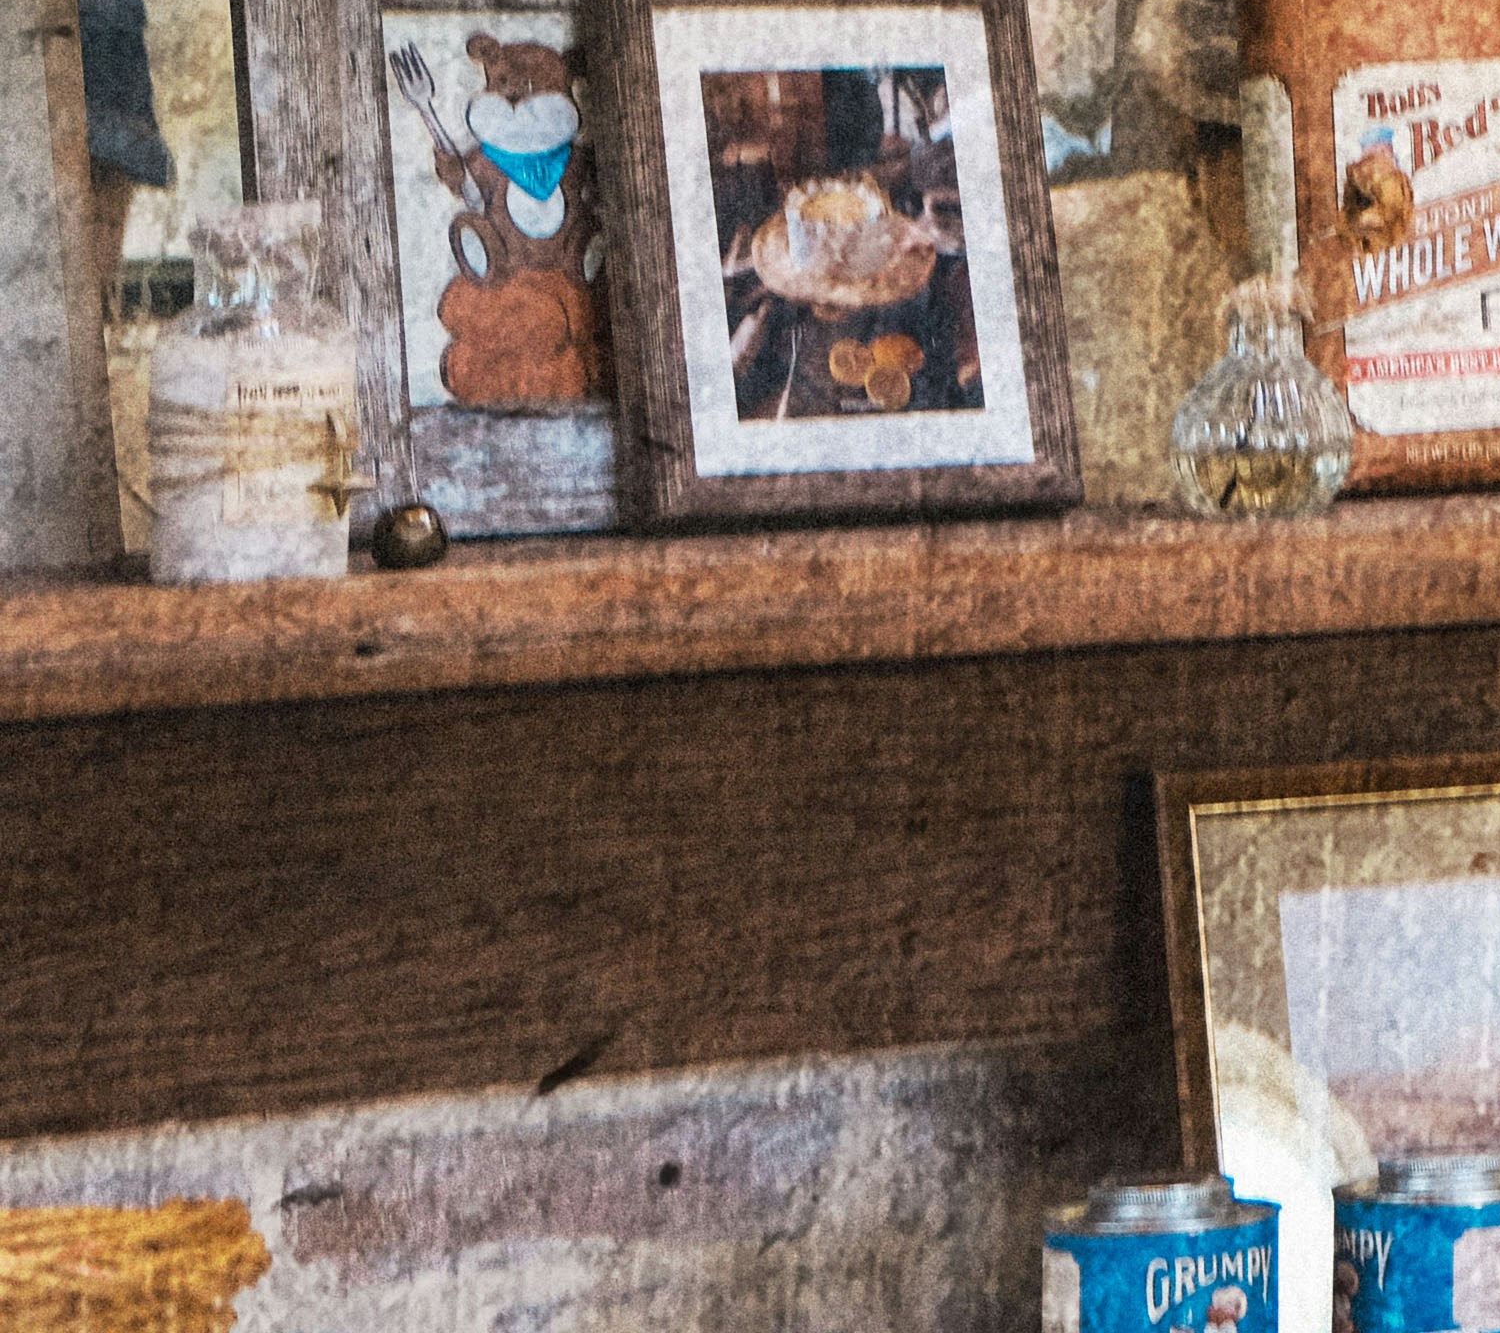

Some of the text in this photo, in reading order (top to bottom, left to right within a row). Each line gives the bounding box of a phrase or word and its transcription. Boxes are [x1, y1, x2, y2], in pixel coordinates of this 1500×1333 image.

[1408, 96, 1488, 174] Red
[1351, 223, 1474, 306] WHOLE
[1145, 1244, 1274, 1322] GRUMPY
